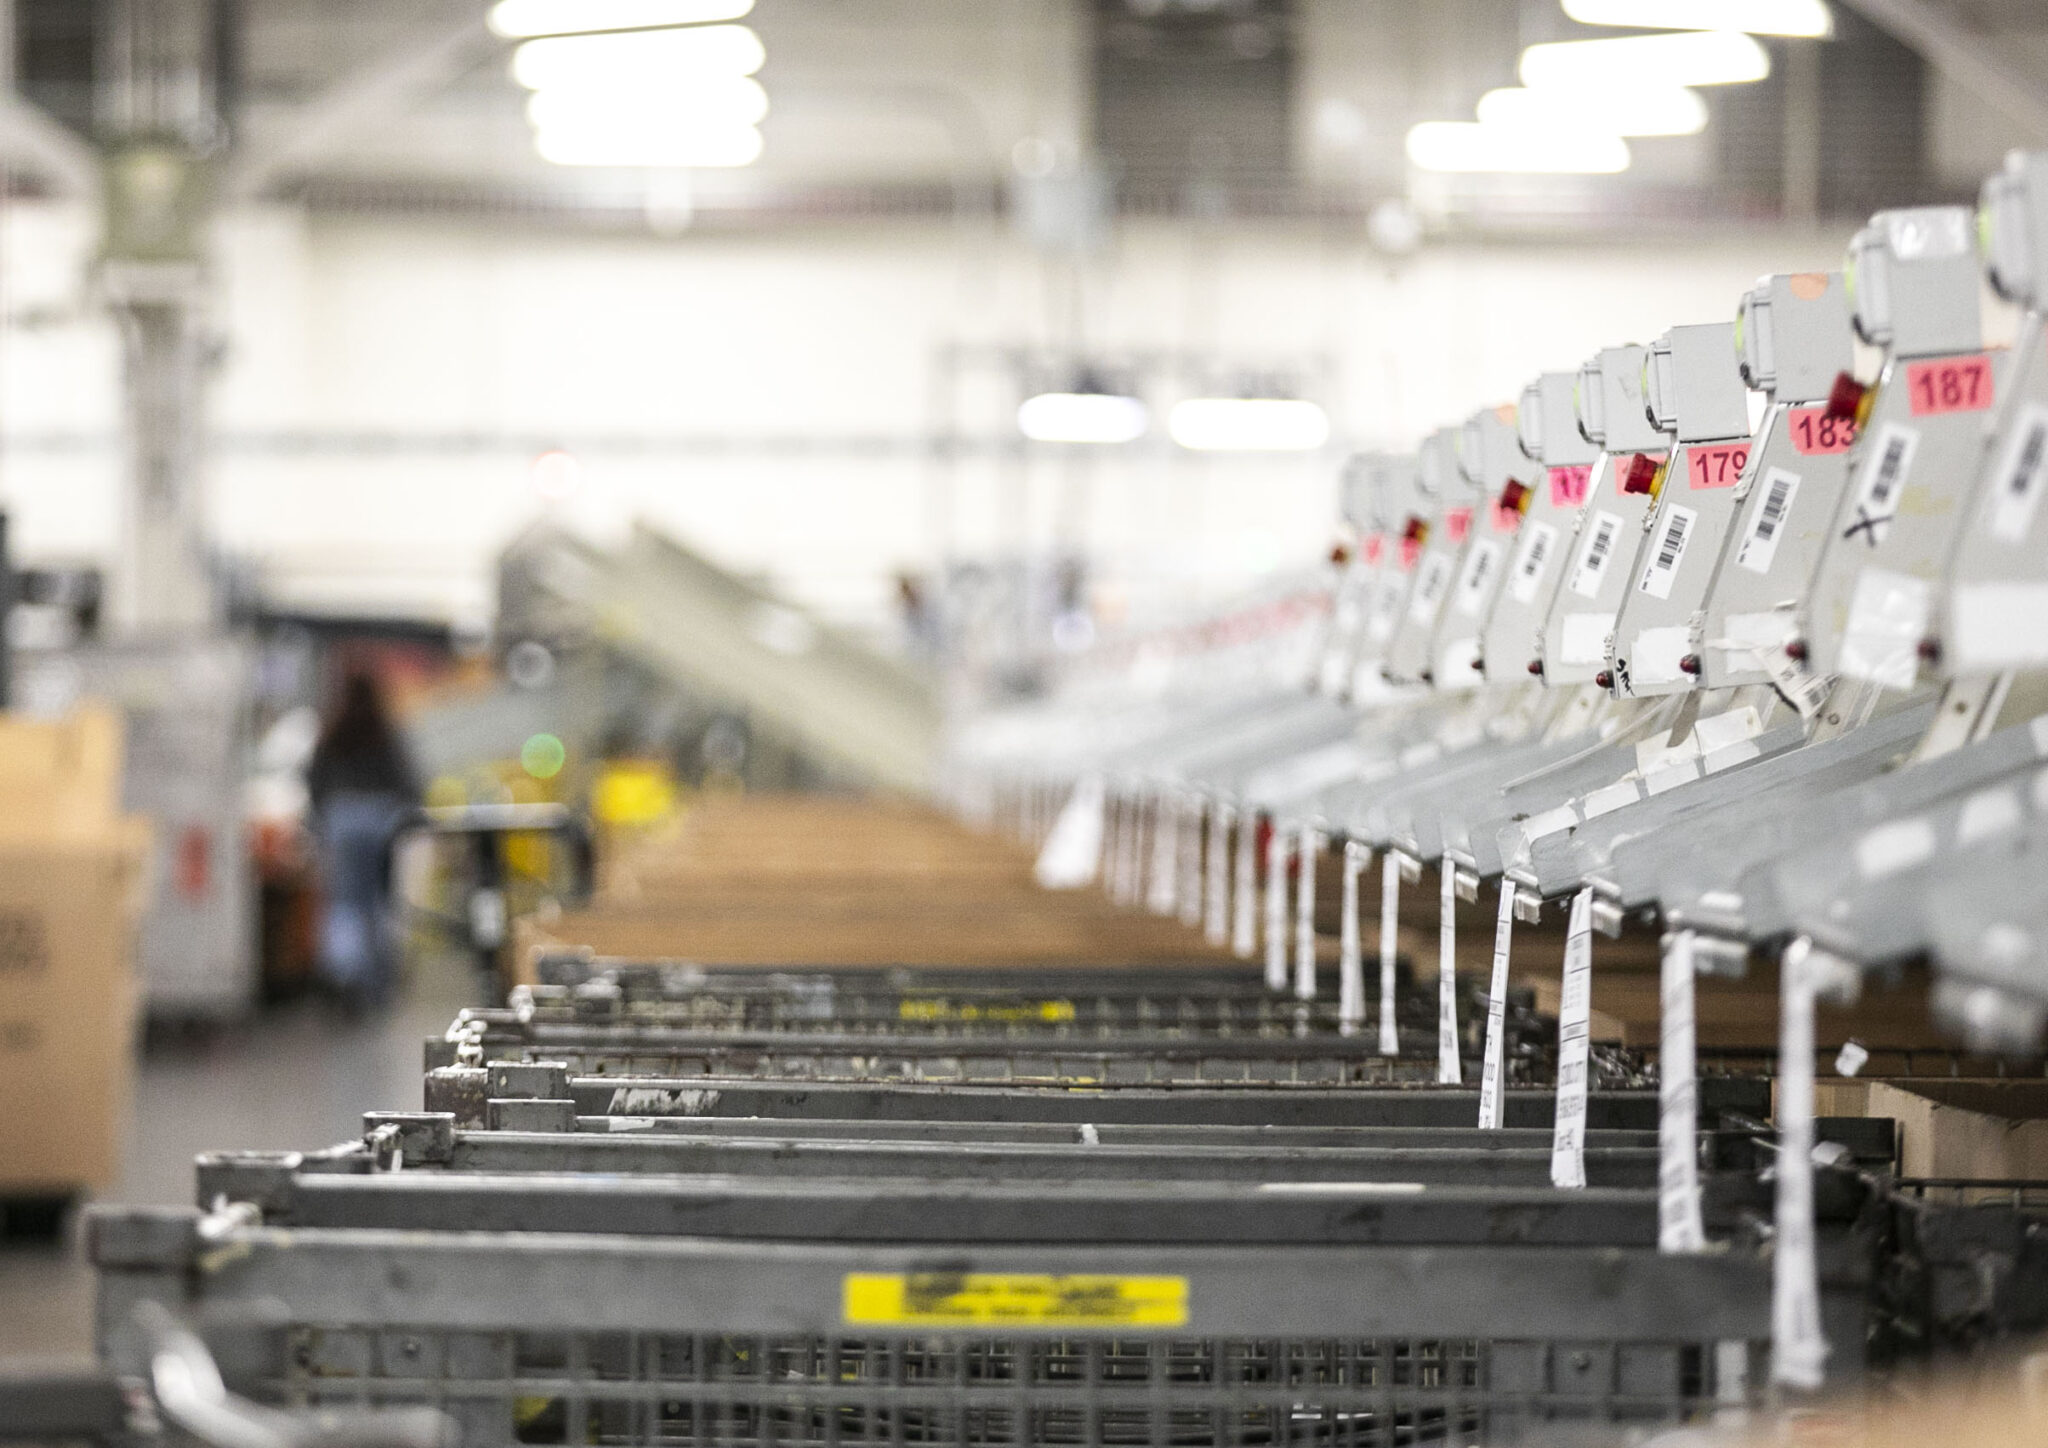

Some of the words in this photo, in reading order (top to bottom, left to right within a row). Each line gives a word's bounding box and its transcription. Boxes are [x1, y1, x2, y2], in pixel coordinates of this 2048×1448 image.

[1918, 365, 1982, 408] 187
[1799, 414, 1857, 449] 183
[1696, 450, 1748, 483] 179
